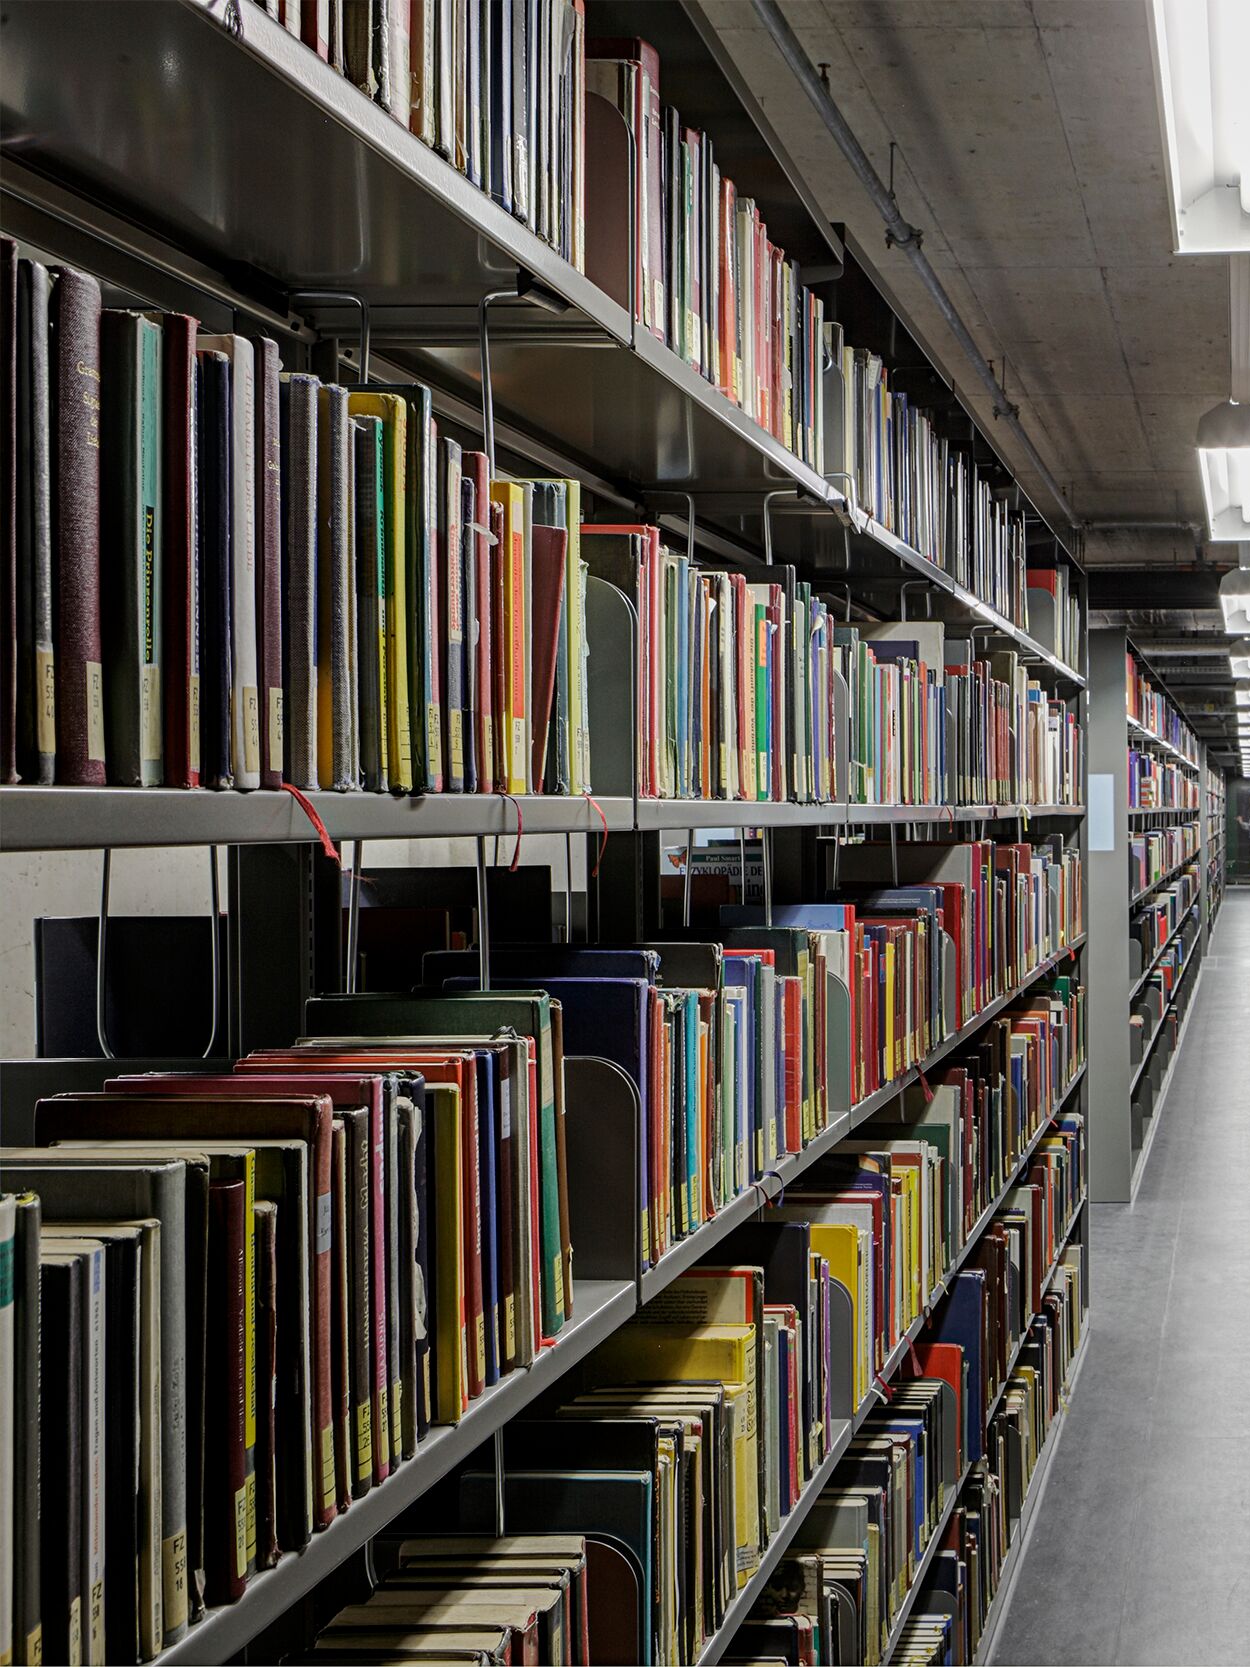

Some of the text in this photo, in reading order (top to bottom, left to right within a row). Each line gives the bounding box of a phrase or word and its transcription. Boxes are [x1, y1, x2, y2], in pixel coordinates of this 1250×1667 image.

[145, 513, 153, 661] Die Prinzenrolle
[680, 864, 749, 876] EZYKLOPÄDE
[173, 1535, 184, 1554] FZ
